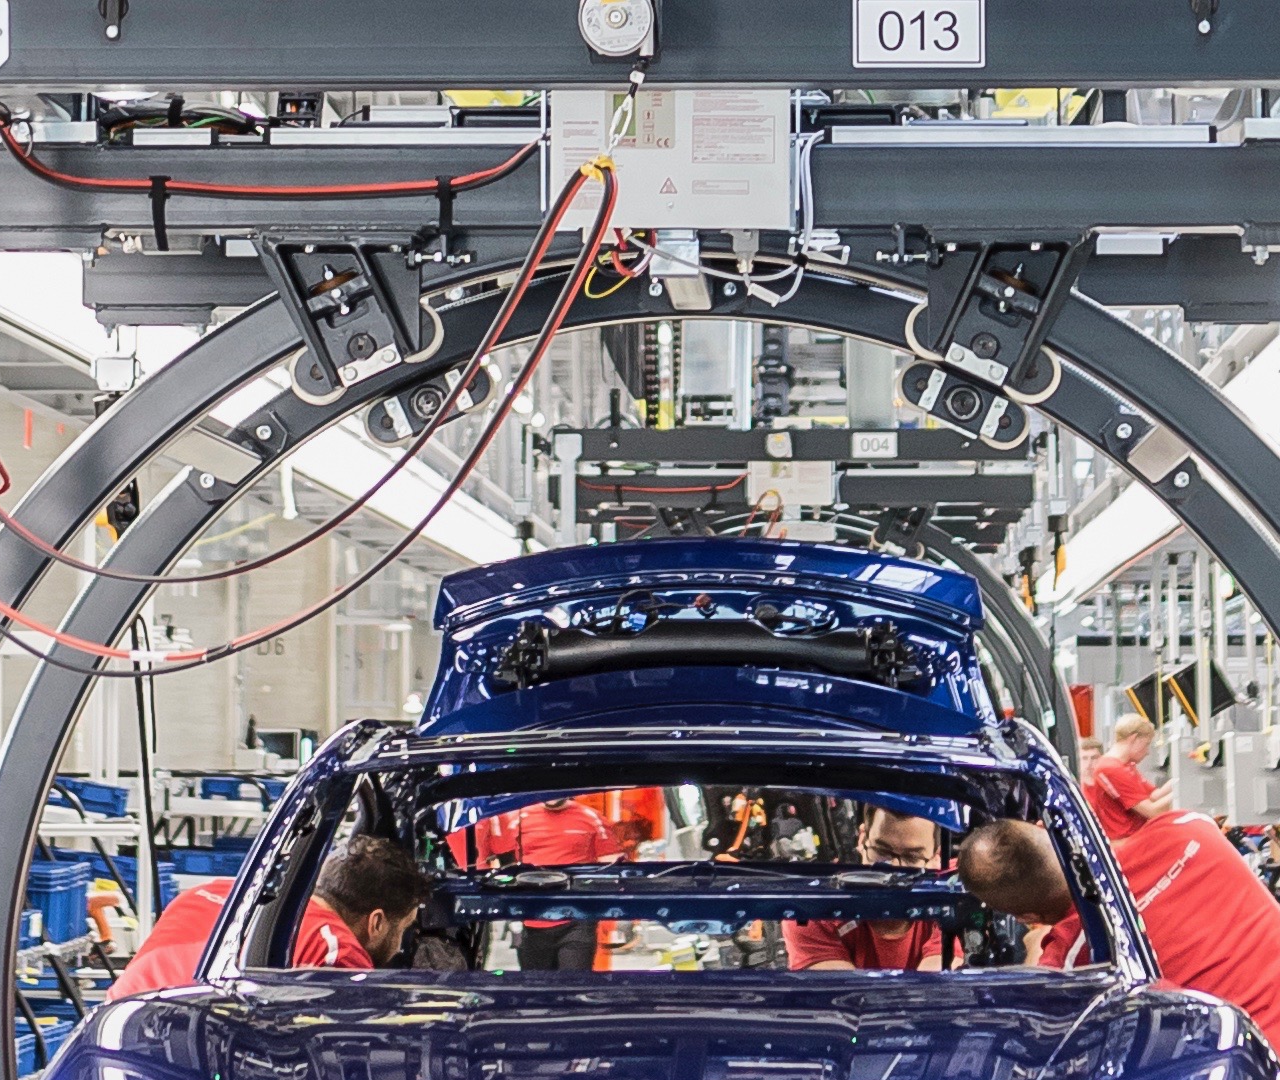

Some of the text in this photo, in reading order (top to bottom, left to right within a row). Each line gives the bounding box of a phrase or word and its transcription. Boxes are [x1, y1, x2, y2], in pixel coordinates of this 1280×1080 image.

[878, 10, 959, 51] 013
[860, 437, 890, 453] 004
[1135, 839, 1201, 913] ORSCHE
